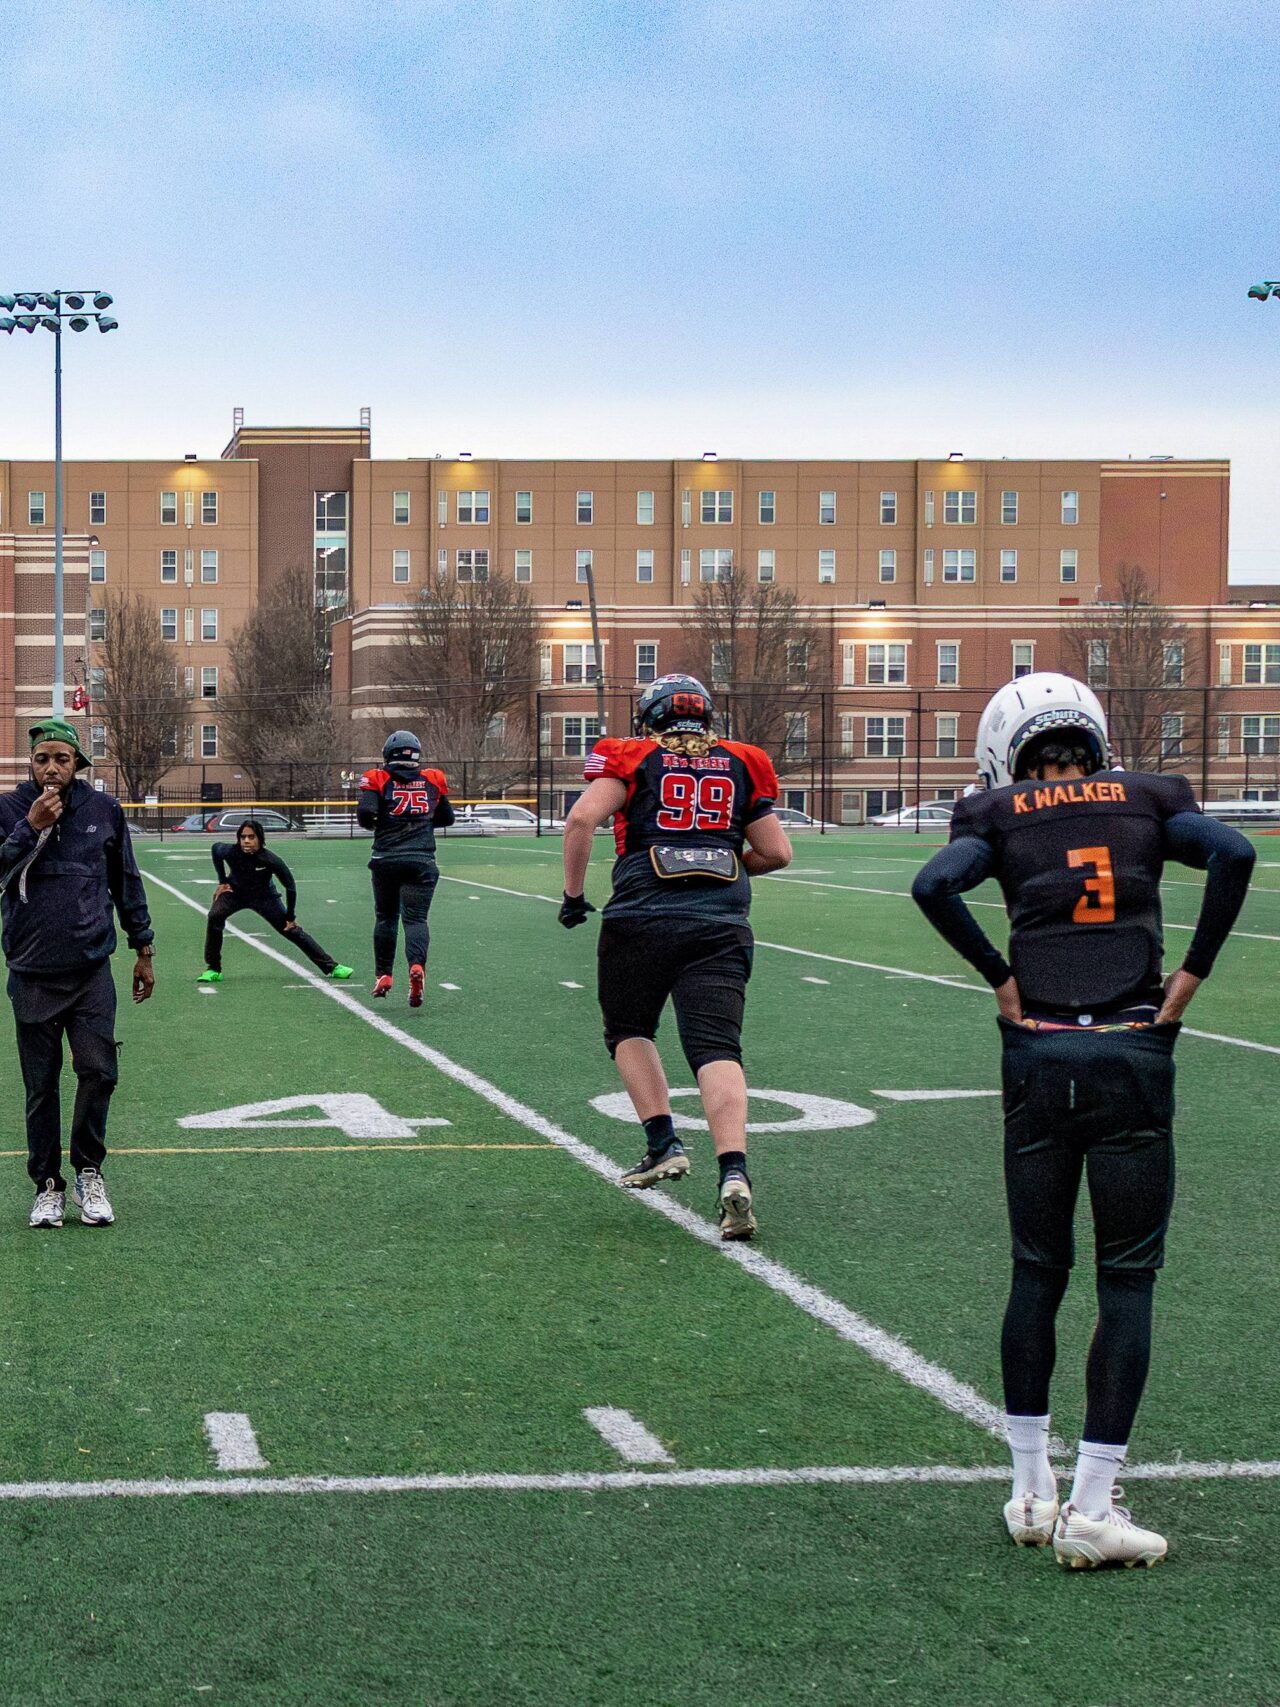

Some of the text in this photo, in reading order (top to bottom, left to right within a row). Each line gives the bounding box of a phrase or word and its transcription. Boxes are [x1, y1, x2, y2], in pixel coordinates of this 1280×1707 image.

[673, 692, 705, 715] 99
[1035, 710, 1079, 725] schutt
[389, 790, 429, 816] 75
[657, 773, 735, 830] 99
[1013, 782, 1126, 814] K. WALKER
[1067, 846, 1115, 923] 3
